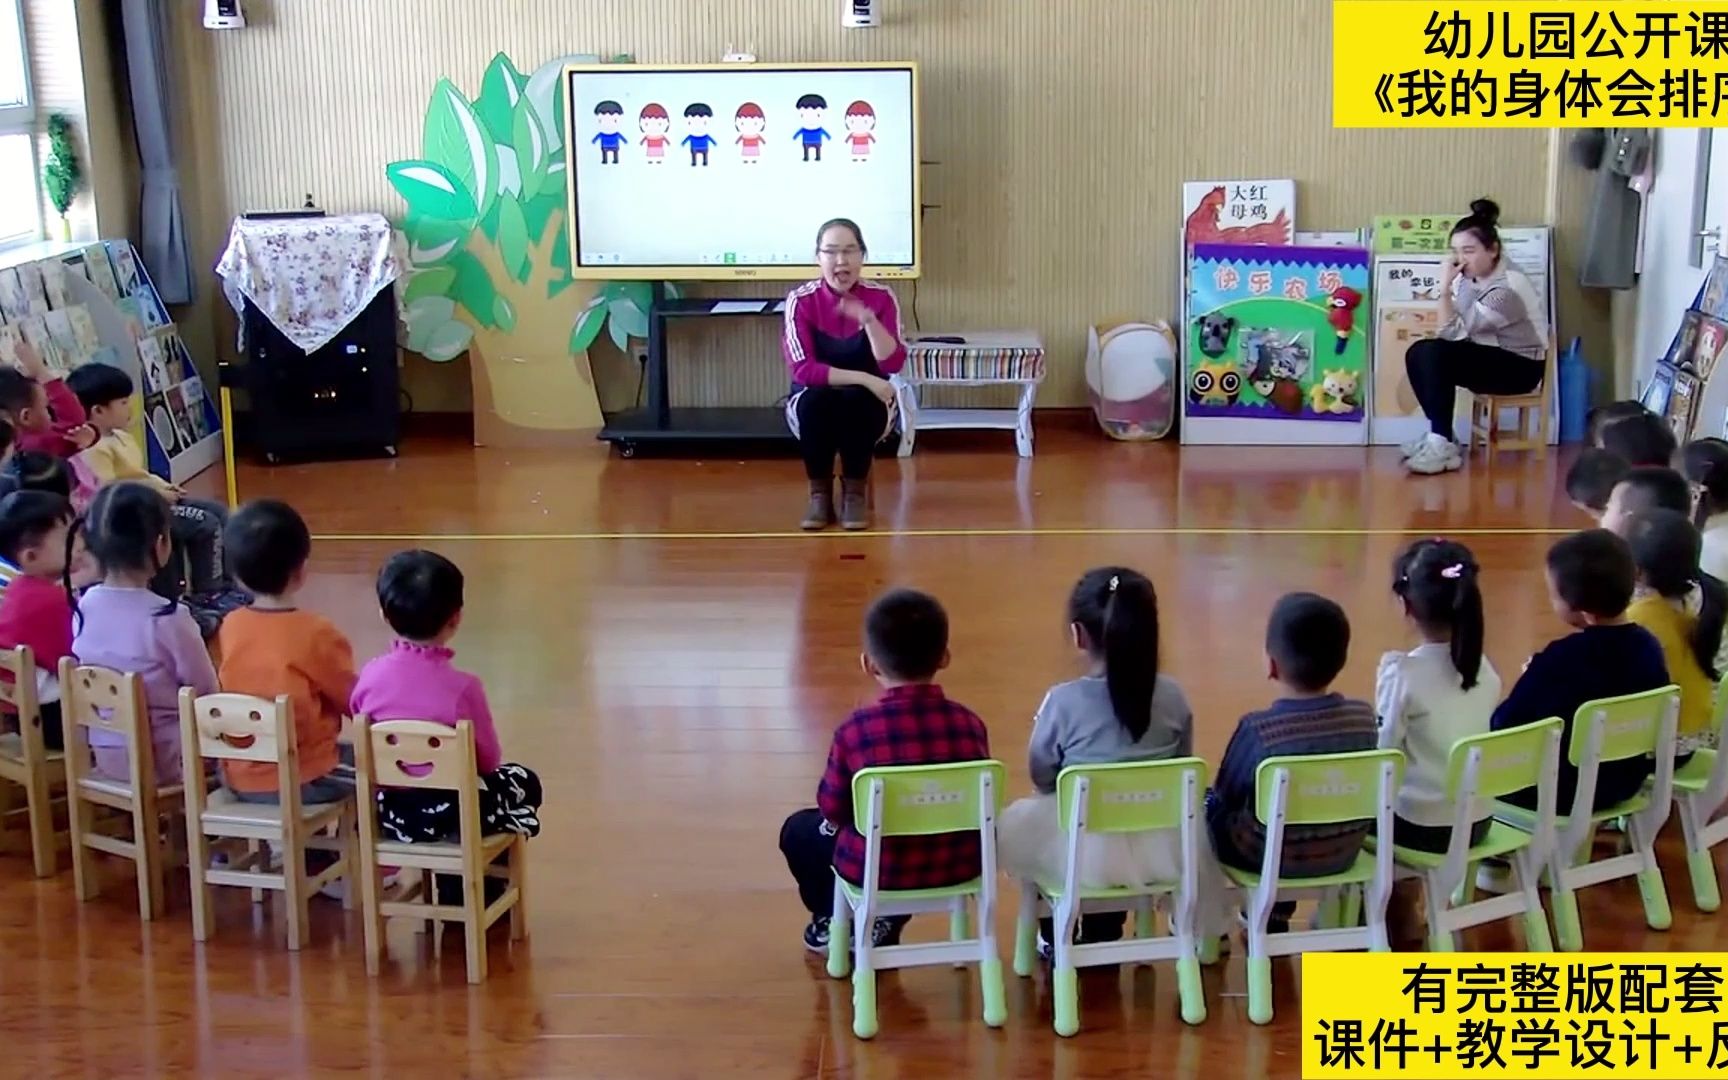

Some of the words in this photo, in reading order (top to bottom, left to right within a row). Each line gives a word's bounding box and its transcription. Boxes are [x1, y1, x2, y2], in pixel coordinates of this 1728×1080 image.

[1230, 185, 1268, 201] 大红
[1230, 203, 1268, 220] 母鸡
[1214, 266, 1343, 301] 快乐农场
